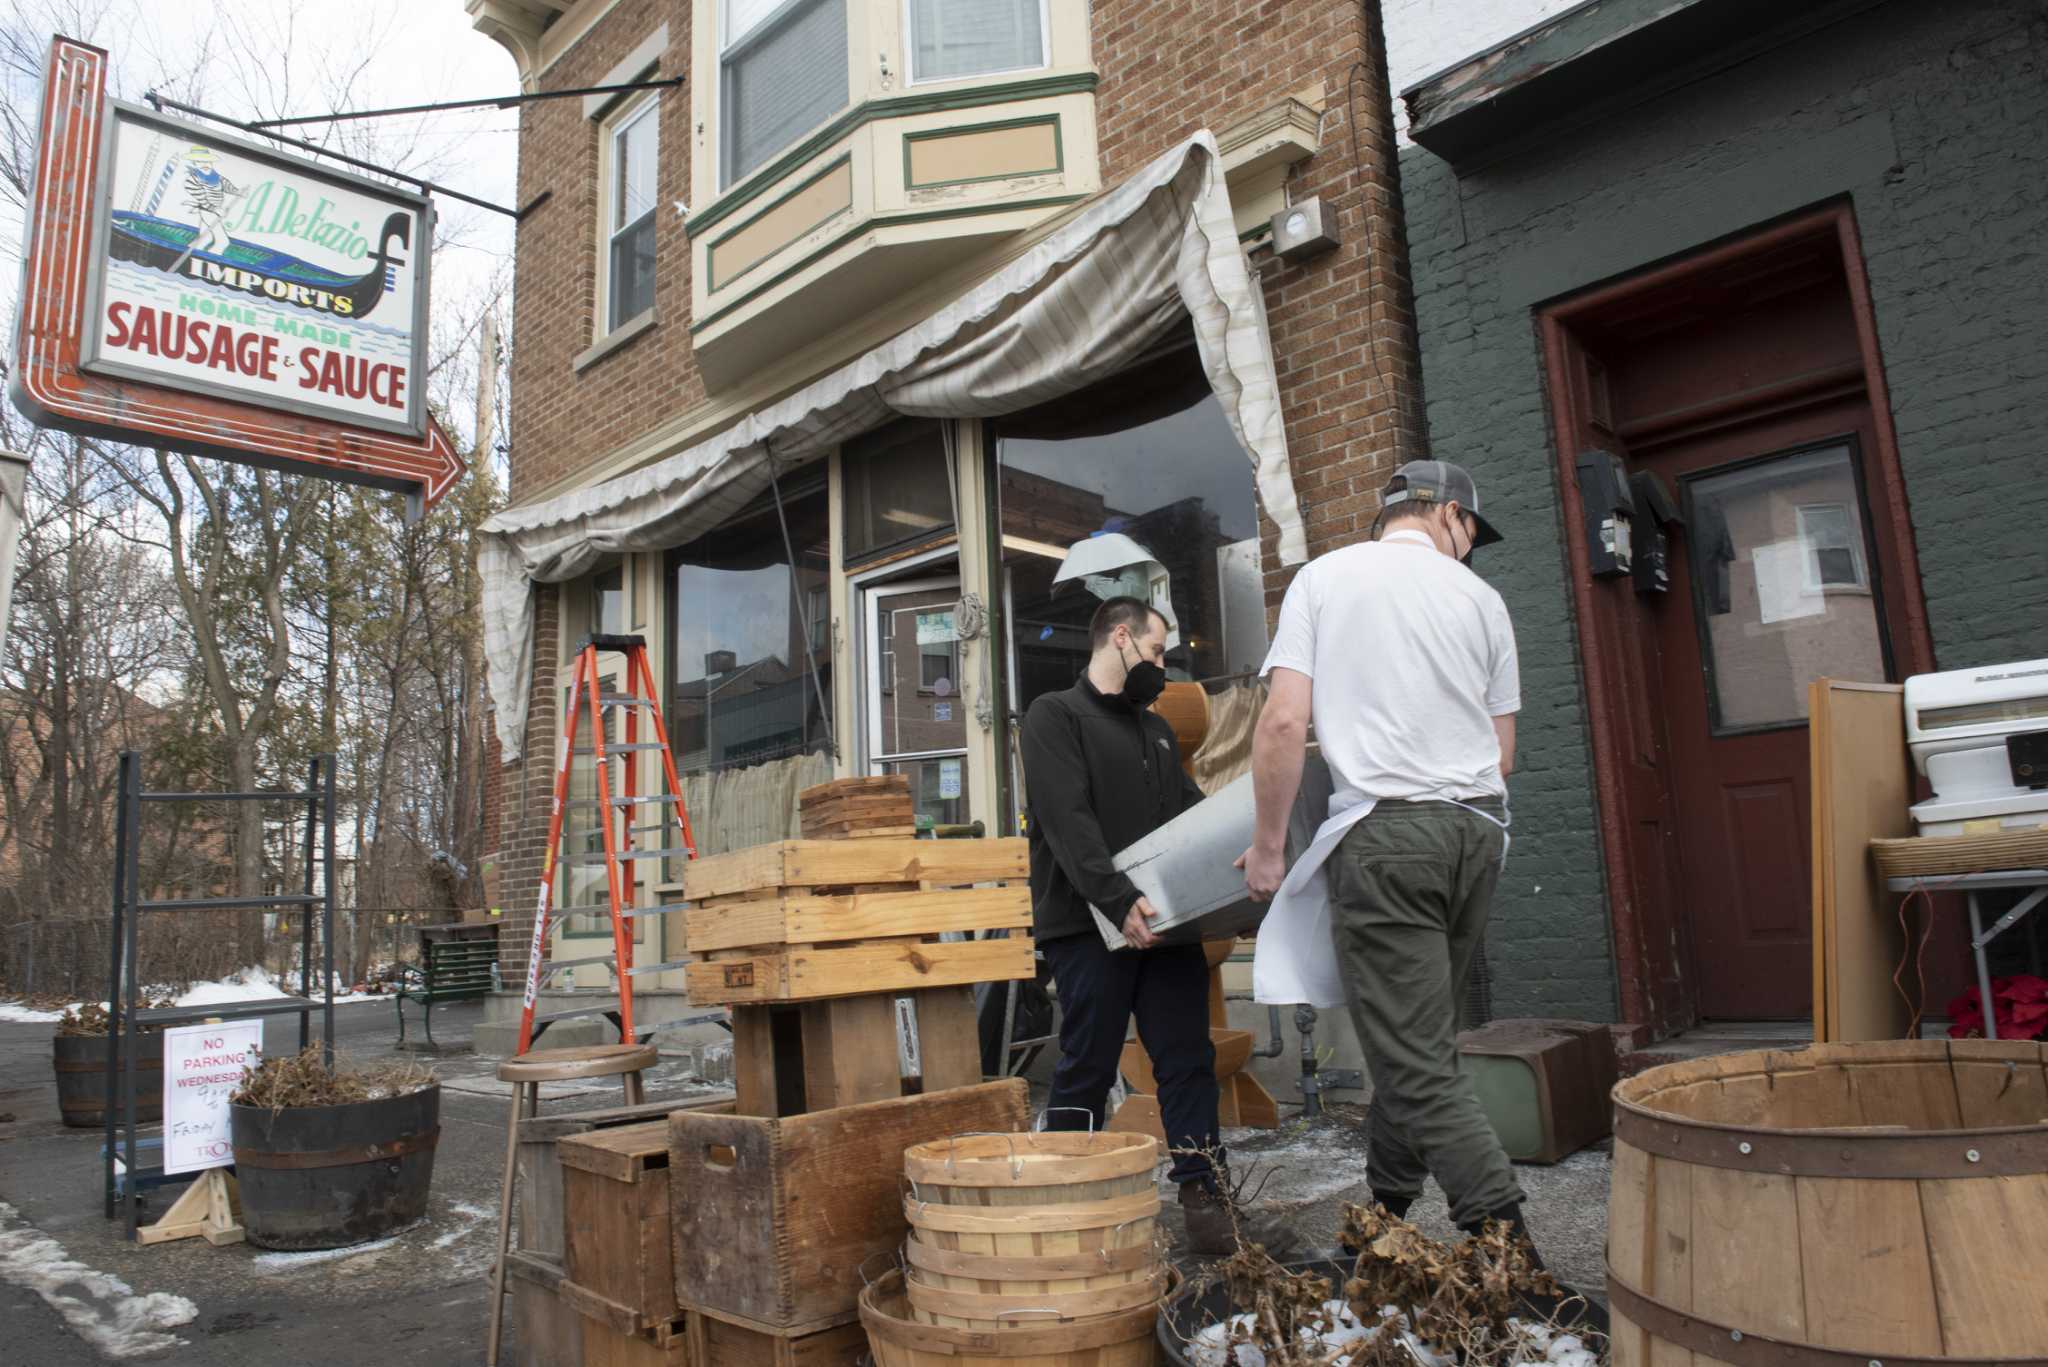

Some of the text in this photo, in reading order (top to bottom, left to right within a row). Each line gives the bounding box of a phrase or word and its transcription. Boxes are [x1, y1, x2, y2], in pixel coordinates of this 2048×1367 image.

[189, 257, 353, 313] IMPORTS
[179, 293, 353, 348] HOME MADE
[106, 301, 279, 381] SAUSAGE
[299, 347, 406, 409] SAUCE
[183, 1053, 246, 1070] PARKING
[203, 1038, 224, 1050] NO
[176, 1071, 245, 1087] WEDNESDA
